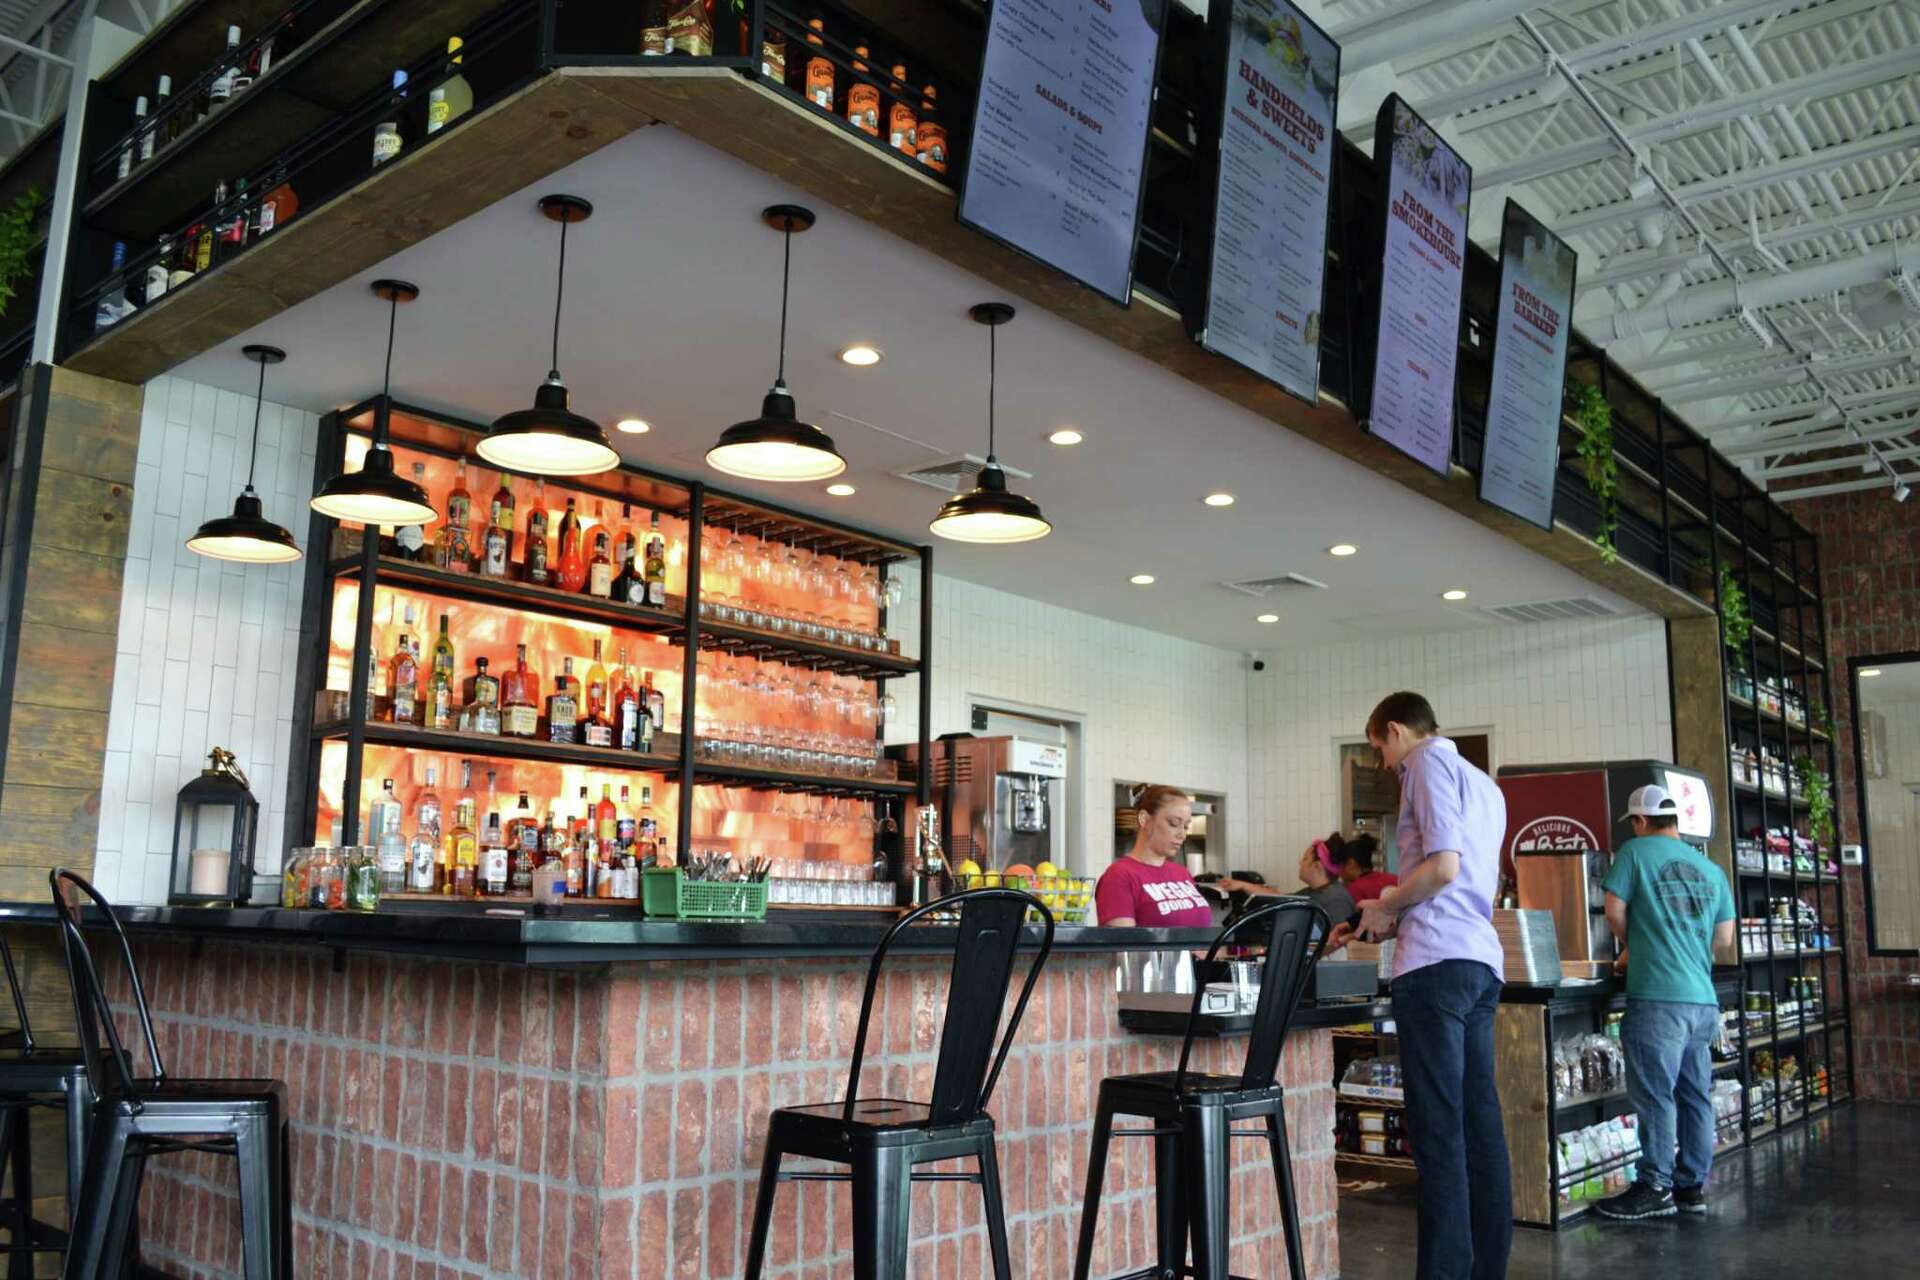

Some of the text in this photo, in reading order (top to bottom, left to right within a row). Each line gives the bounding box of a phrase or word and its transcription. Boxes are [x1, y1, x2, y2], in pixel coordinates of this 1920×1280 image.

[1036, 82, 1068, 112] SALADS
[1077, 110, 1103, 135] SOUPS
[1239, 59, 1325, 142] HANDHELDS
[1246, 87, 1316, 155] & SWEETS
[1391, 199, 1461, 271] SMOKEHOUSE
[1402, 188, 1457, 247] FROM THE
[1512, 282, 1560, 327] FROM THE
[1513, 300, 1557, 338] BARKEEP
[1533, 821, 1571, 837] DELICIOUS
